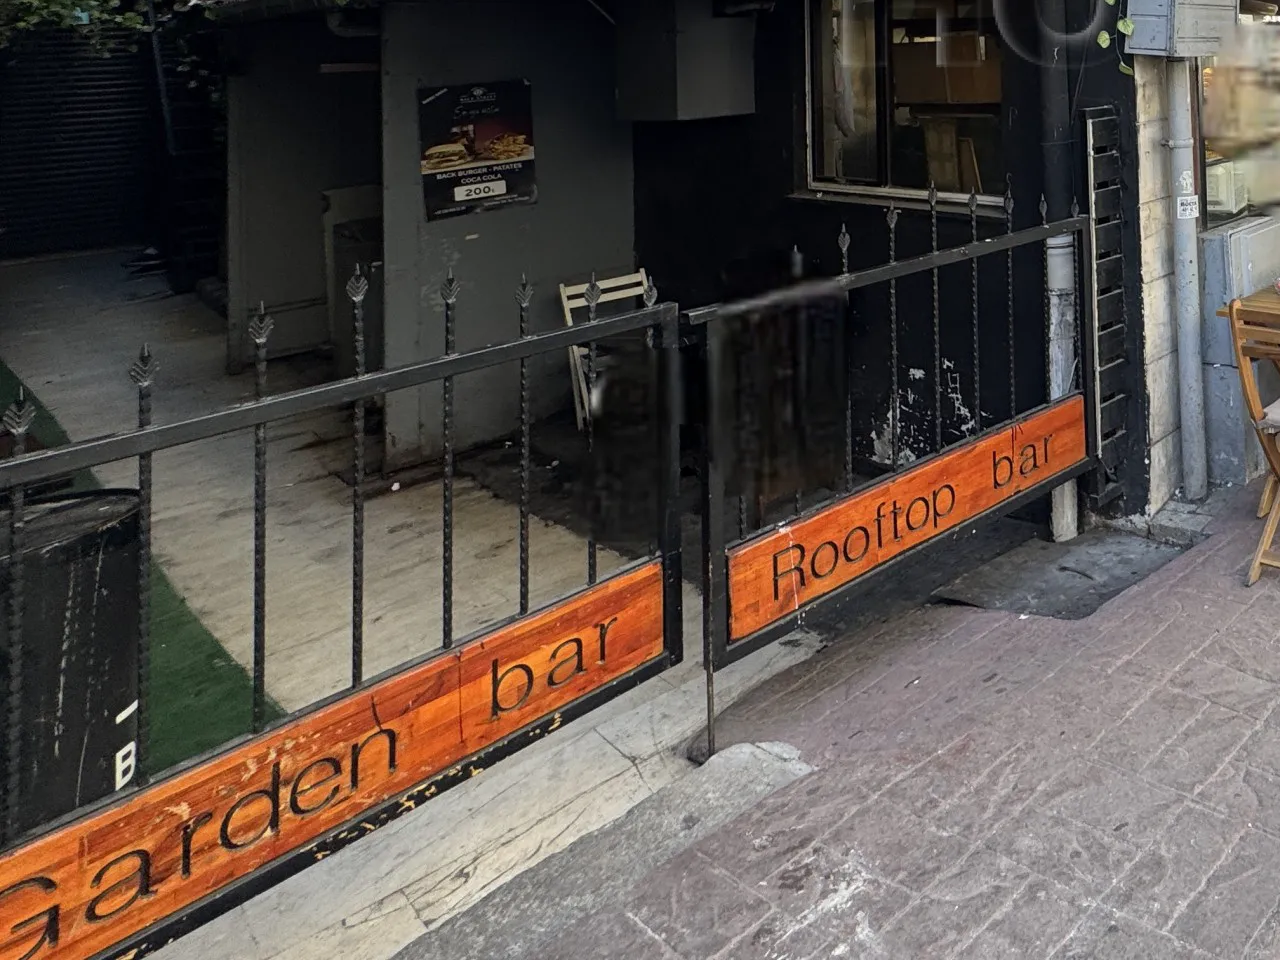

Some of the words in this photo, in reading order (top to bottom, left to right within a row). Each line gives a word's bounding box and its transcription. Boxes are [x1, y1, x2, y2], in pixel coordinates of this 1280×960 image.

[436, 172, 457, 180] BACK
[458, 167, 487, 176] BURGER
[461, 176, 481, 184] COCA
[482, 173, 502, 181] COLA
[771, 482, 955, 601] Rooftop
[992, 432, 1054, 490] bar
[0, 727, 398, 960] Garden
[493, 614, 617, 720] bar
